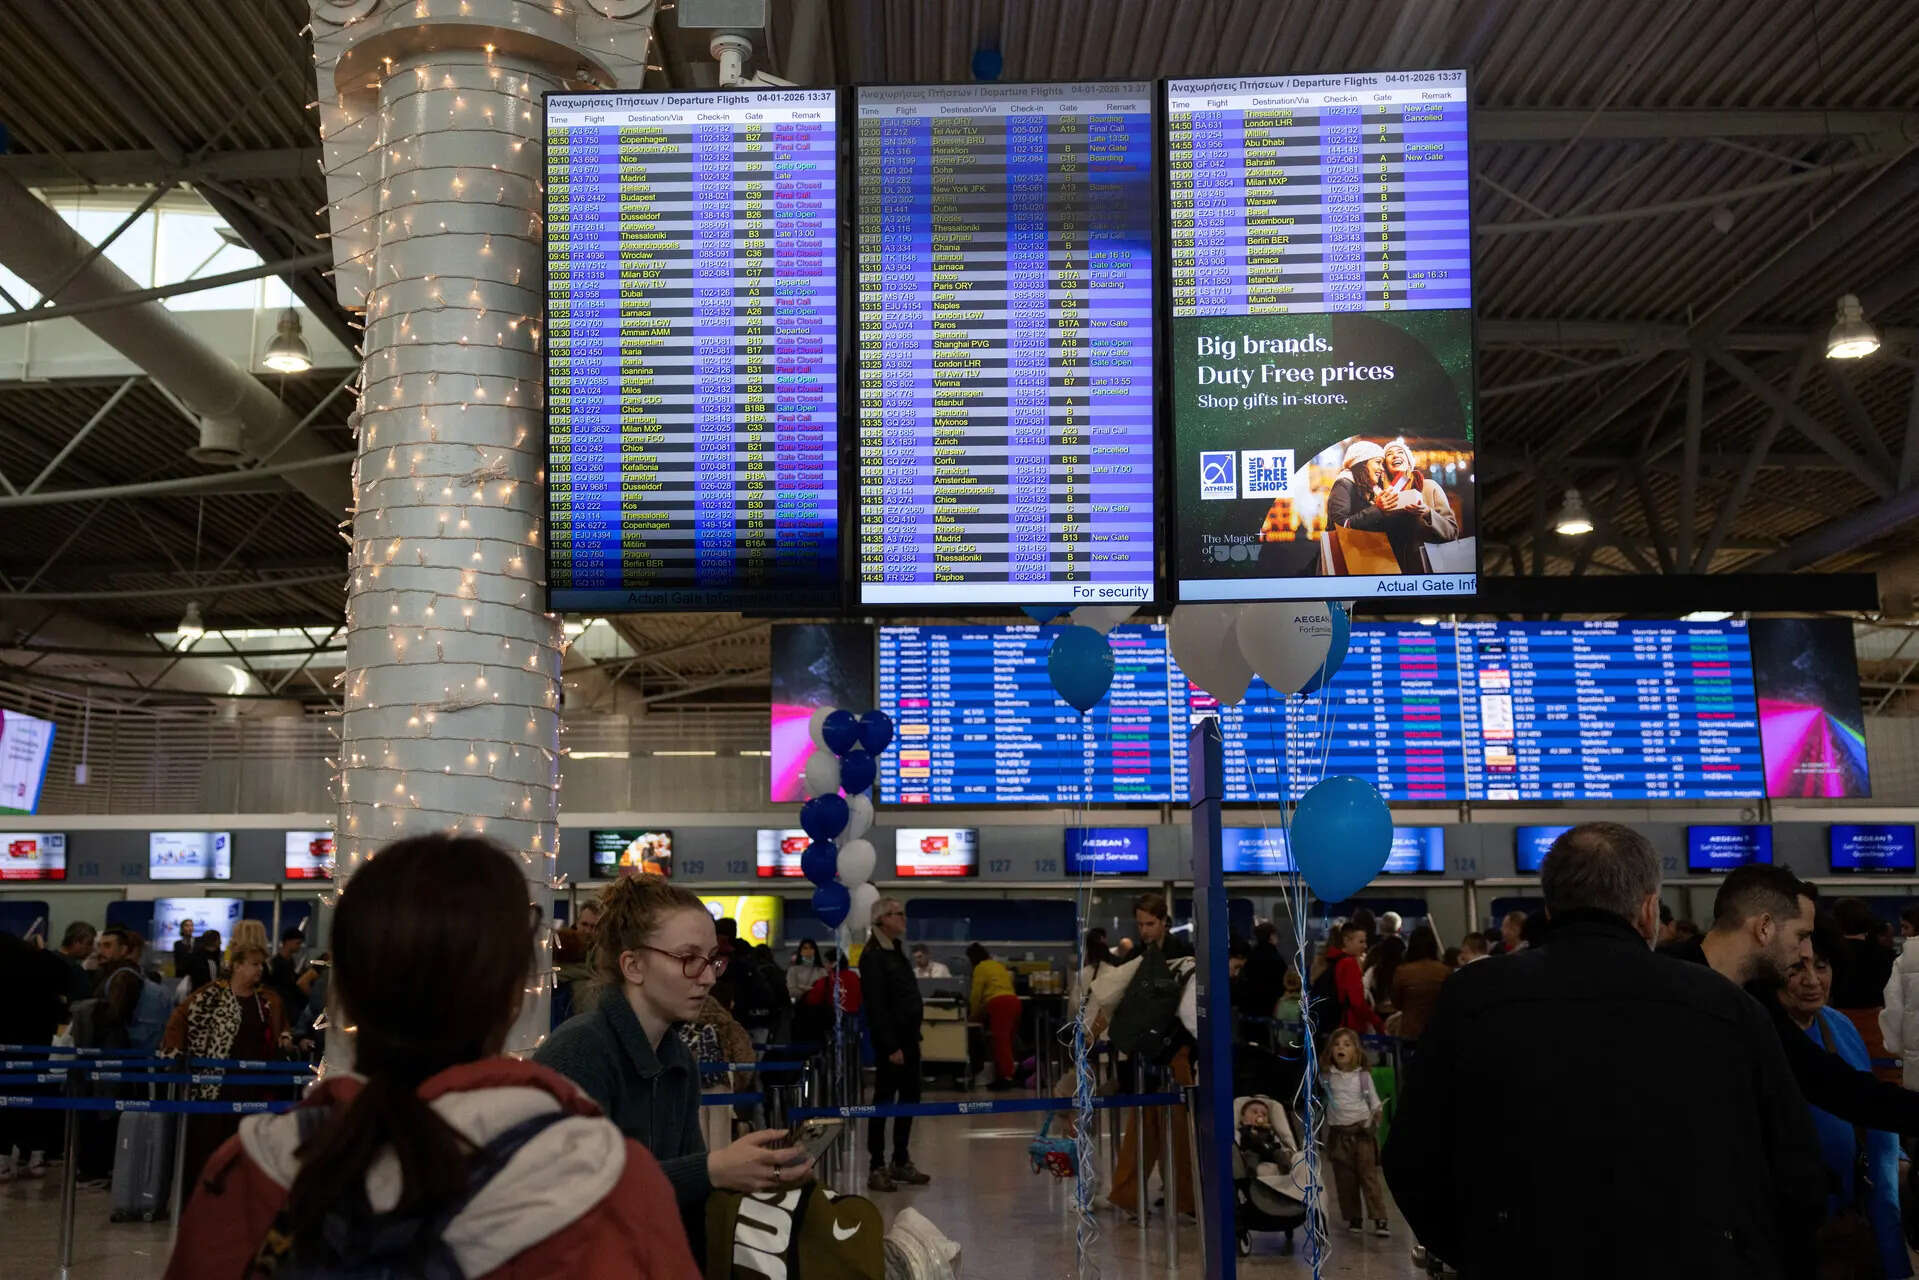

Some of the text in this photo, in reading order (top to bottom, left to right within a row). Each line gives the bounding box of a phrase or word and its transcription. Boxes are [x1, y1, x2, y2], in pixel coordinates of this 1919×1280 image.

[1171, 83, 1237, 94] Αναχωρήσεις
[1240, 80, 1284, 90] Πτήσεων
[1292, 77, 1340, 89] Departure
[1344, 76, 1378, 87] Flights
[1385, 74, 1435, 83] 04-01-2026
[1438, 72, 1462, 81] 13:37
[980, 87, 1027, 98] Departure
[1031, 86, 1063, 97] Flights
[549, 98, 613, 109] Αναχωρήσεις
[616, 96, 659, 108] Πτήσεων
[667, 95, 714, 106] Departure
[717, 95, 750, 105] Flights
[757, 93, 805, 102] 04-01-2026
[807, 92, 832, 101] 13:37
[1172, 91, 1452, 109] Time Flight Destination/Via Check-in Gate Remark
[896, 106, 917, 115] Flight
[940, 105, 997, 113] Destination/Via
[1010, 104, 1044, 112] Check-in
[584, 115, 605, 124] Flight
[628, 114, 684, 122] Destination/Via
[697, 112, 730, 121] Check-in
[745, 112, 763, 120] Gate
[792, 111, 821, 119] Remark
[1245, 119, 1273, 127] London
[1275, 118, 1293, 126] LHR
[1404, 114, 1443, 122] Cancelled
[620, 136, 668, 145] Copenhagen
[1262, 138, 1285, 146] Dhabi
[1245, 159, 1276, 167] Bahrain
[1246, 178, 1266, 186] Milan
[620, 193, 656, 202] Budapest
[1246, 198, 1277, 206] Warsaw
[1247, 217, 1295, 226] Luxembourg
[1248, 236, 1289, 245] Berlin BER
[1407, 271, 1424, 279] Late
[933, 282, 953, 290] Paris
[1090, 281, 1125, 289] Boarding
[1248, 295, 1276, 303] Munich
[933, 302, 961, 310] Naples
[651, 328, 671, 336] AMM
[775, 327, 811, 335] Departed
[934, 340, 990, 349] Shanghai PVG
[1197, 333, 1334, 360] Big brands.
[964, 359, 982, 367] LHR
[1198, 361, 1395, 389] Duty Free prices
[1198, 392, 1348, 411] Shop gifts in-store.
[934, 419, 969, 427] Mykonos
[935, 457, 956, 465] Corfu
[1256, 456, 1287, 468] DTY
[1248, 457, 1257, 492] HELLENIC
[1256, 468, 1288, 481] FREE
[1256, 481, 1288, 492] SHOPS
[622, 521, 670, 530] Copenhagen
[1201, 534, 1255, 544] The Magic
[1202, 545, 1213, 554] of
[935, 573, 964, 582] Paphos
[1376, 578, 1477, 592] Actual Gate Inf
[1073, 585, 1149, 600] For security
[1075, 852, 1139, 861] Special Services
